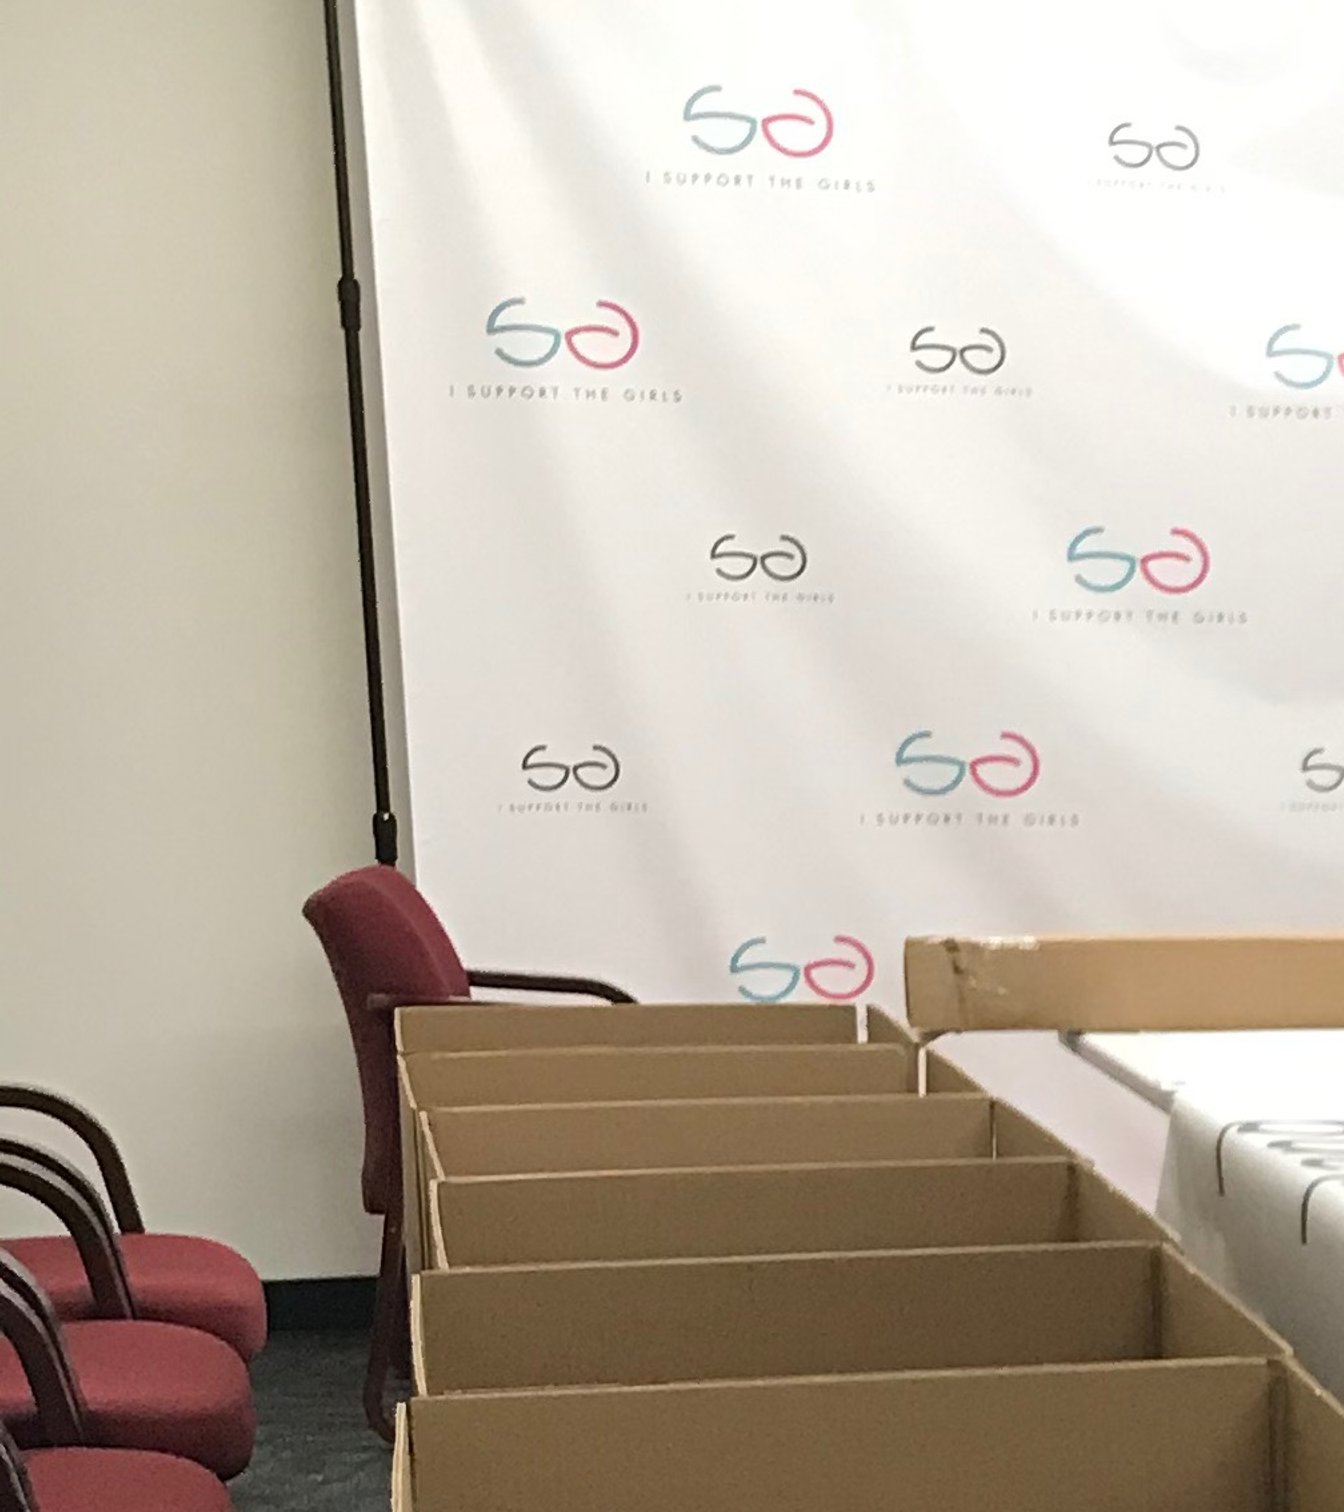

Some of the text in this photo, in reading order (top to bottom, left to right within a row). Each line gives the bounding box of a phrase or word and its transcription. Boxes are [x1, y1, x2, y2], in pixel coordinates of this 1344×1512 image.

[663, 170, 754, 187] SUPPORT
[768, 174, 803, 190] THE
[817, 177, 876, 193] GIRLS
[466, 384, 559, 400] SUPPORT
[573, 386, 609, 402] THE
[622, 388, 682, 403] GIRLS
[1048, 608, 1133, 623] SUPPORT
[1145, 608, 1179, 624] THE
[1192, 610, 1247, 625] GIRLS
[876, 811, 962, 826] SUPPORT
[975, 811, 1009, 826] THE
[1023, 812, 1080, 828] GIRLS
